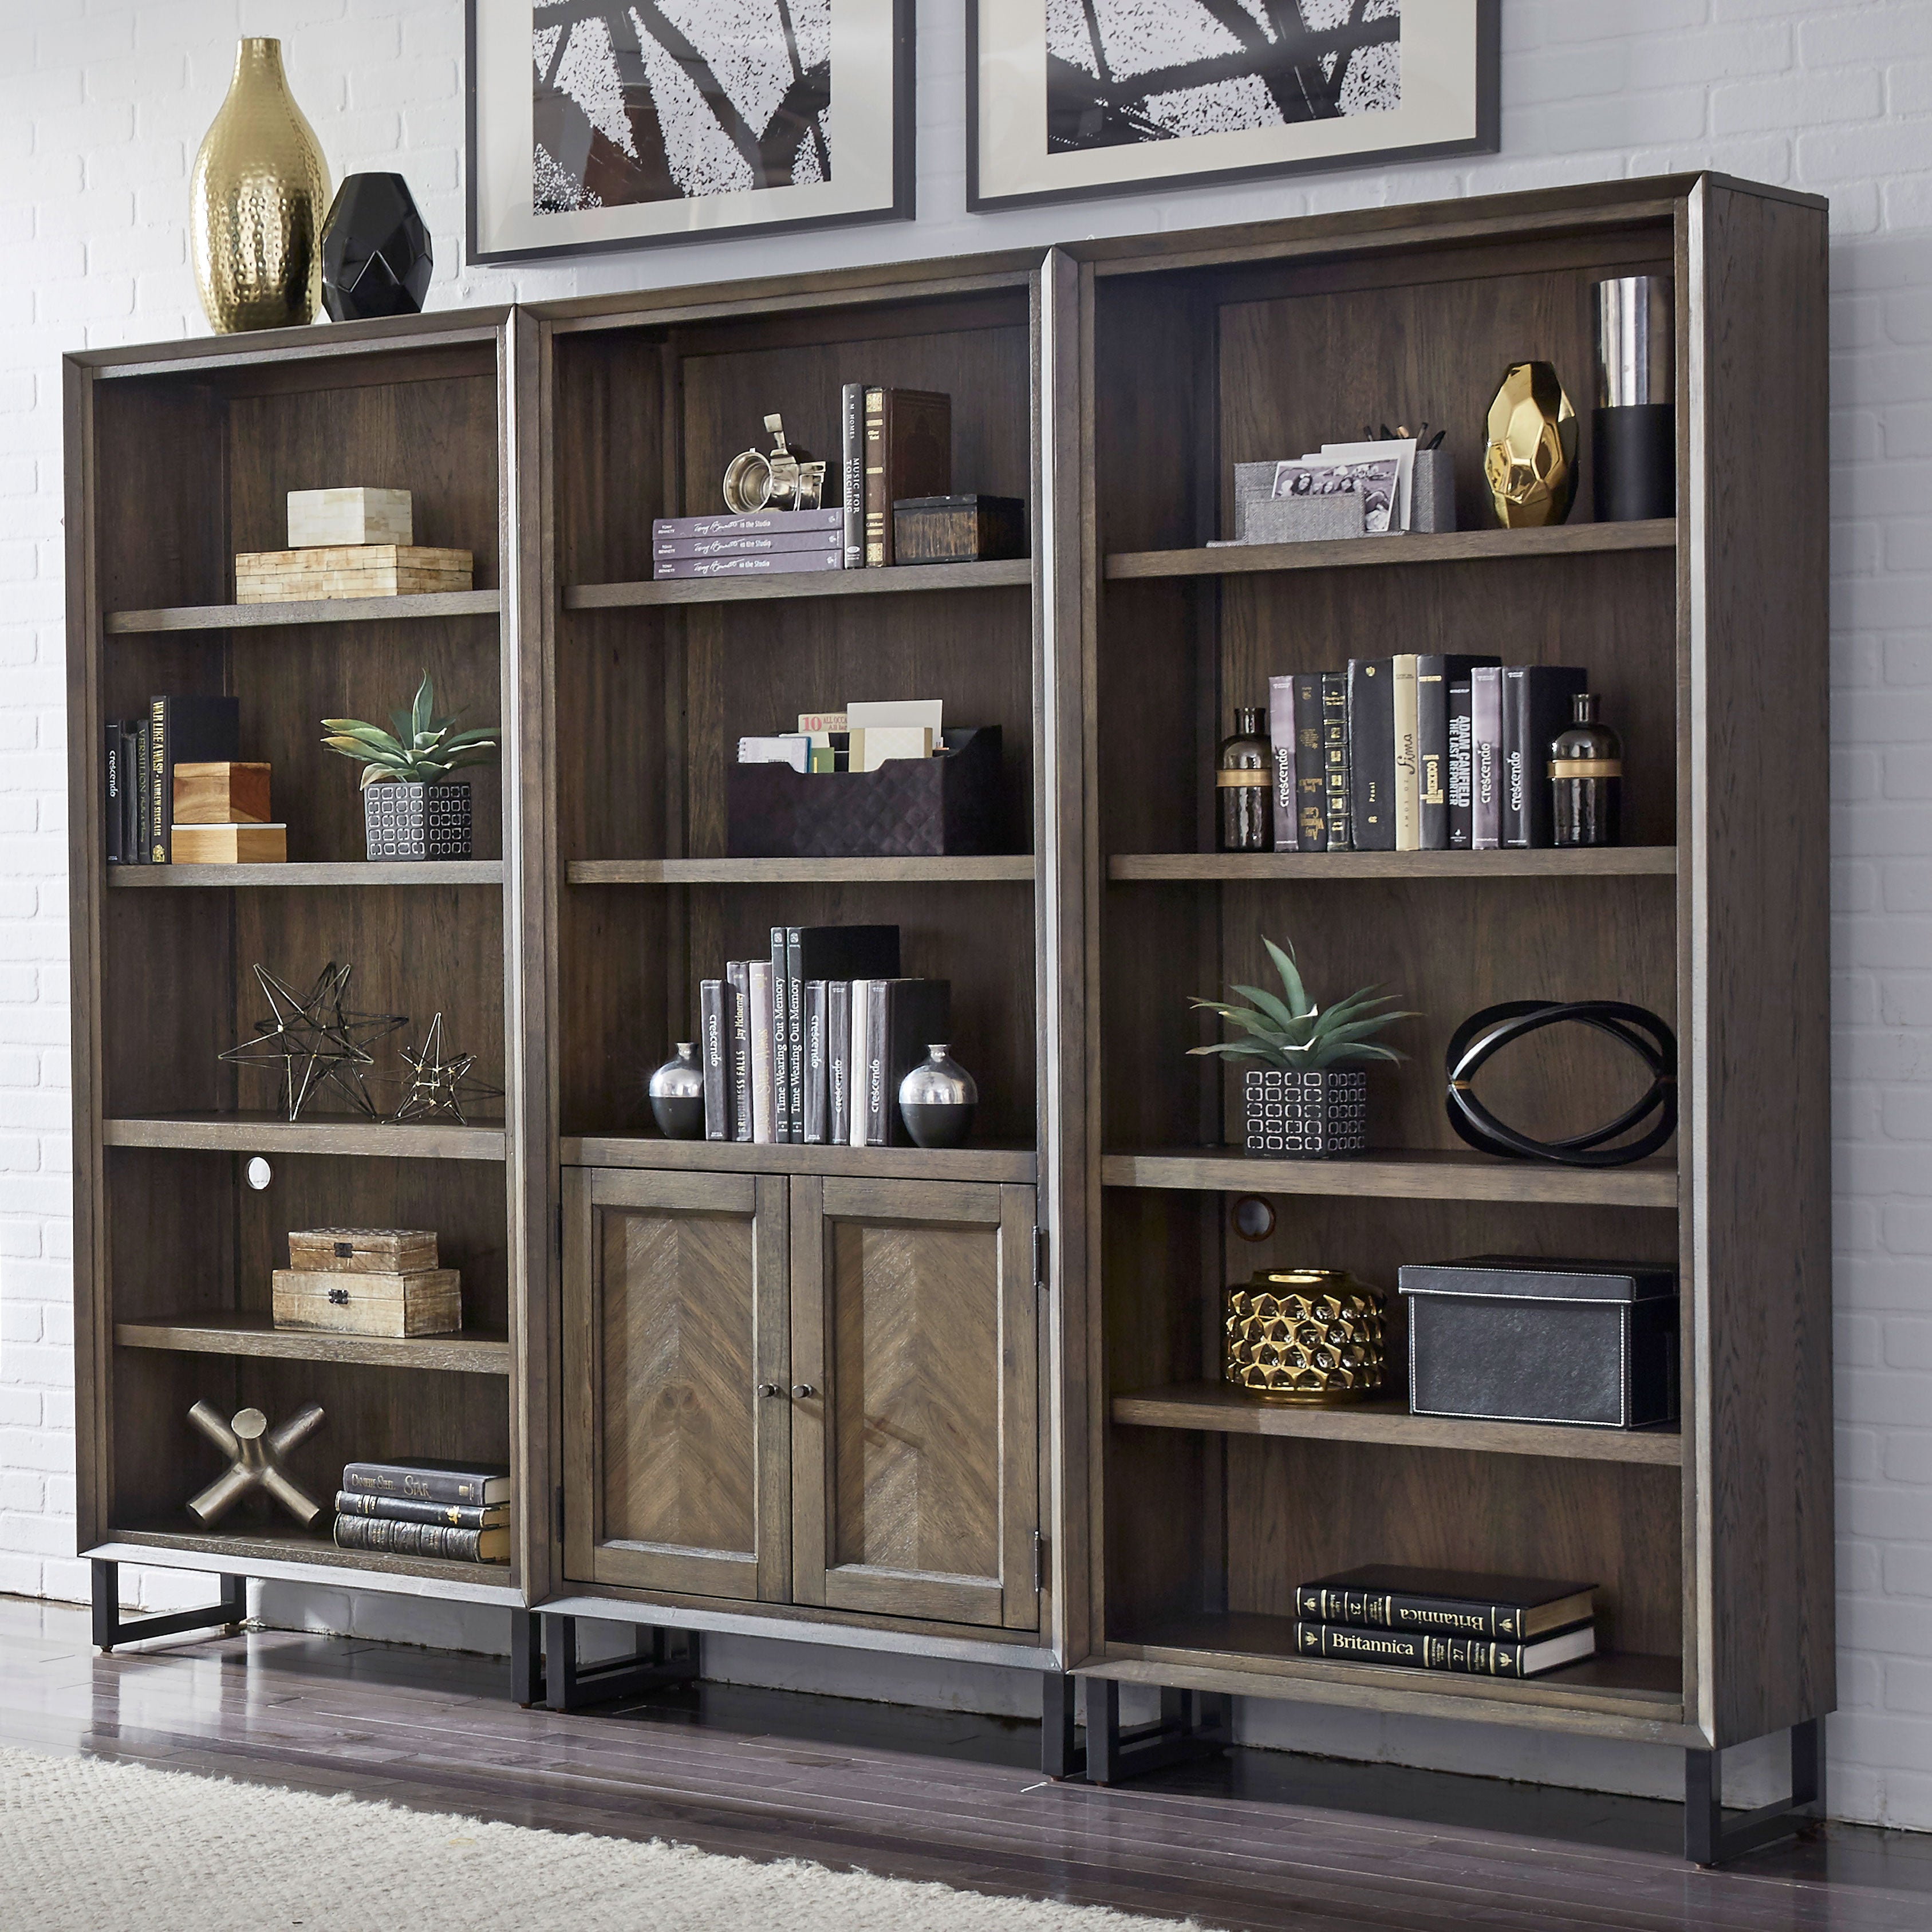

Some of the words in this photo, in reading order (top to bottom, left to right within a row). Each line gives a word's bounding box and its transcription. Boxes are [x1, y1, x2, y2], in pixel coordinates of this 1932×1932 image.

[755, 519, 771, 527] Studio
[755, 539, 771, 547] Studio
[153, 701, 164, 721] WAR
[802, 716, 822, 731] 10
[153, 723, 164, 742] LIKE
[1449, 718, 1458, 736] THE
[1458, 715, 1470, 749] ADAM
[1449, 738, 1460, 759] LAST
[109, 750, 118, 798] crescendo
[153, 750, 164, 774] WASP
[1477, 743, 1492, 803] crescendo
[1275, 748, 1289, 807] crescendo
[1449, 760, 1459, 806] REPORTER
[1458, 751, 1470, 807] CANFIELD
[1506, 751, 1521, 811] crescendo
[153, 806, 161, 836] SINCLAIR
[774, 976, 786, 1019] Memory
[789, 976, 801, 1020] Memory
[709, 1014, 721, 1067] crescendo
[735, 1028, 746, 1041] Jay
[775, 1022, 784, 1042] Out
[790, 1022, 799, 1042] Out
[811, 1015, 822, 1068] crescendo
[735, 1050, 745, 1076] FALLS
[775, 1044, 787, 1085] Wearing
[790, 1044, 802, 1086] Wearing
[832, 1059, 842, 1113] crescendo
[869, 1059, 880, 1113] crescendo
[776, 1087, 786, 1113] Time
[791, 1087, 801, 1114] Time
[1350, 1603, 1362, 1615] 23
[1399, 1608, 1484, 1631] Britannica
[1332, 1633, 1414, 1655] Britannica
[1453, 1648, 1464, 1661] 27
